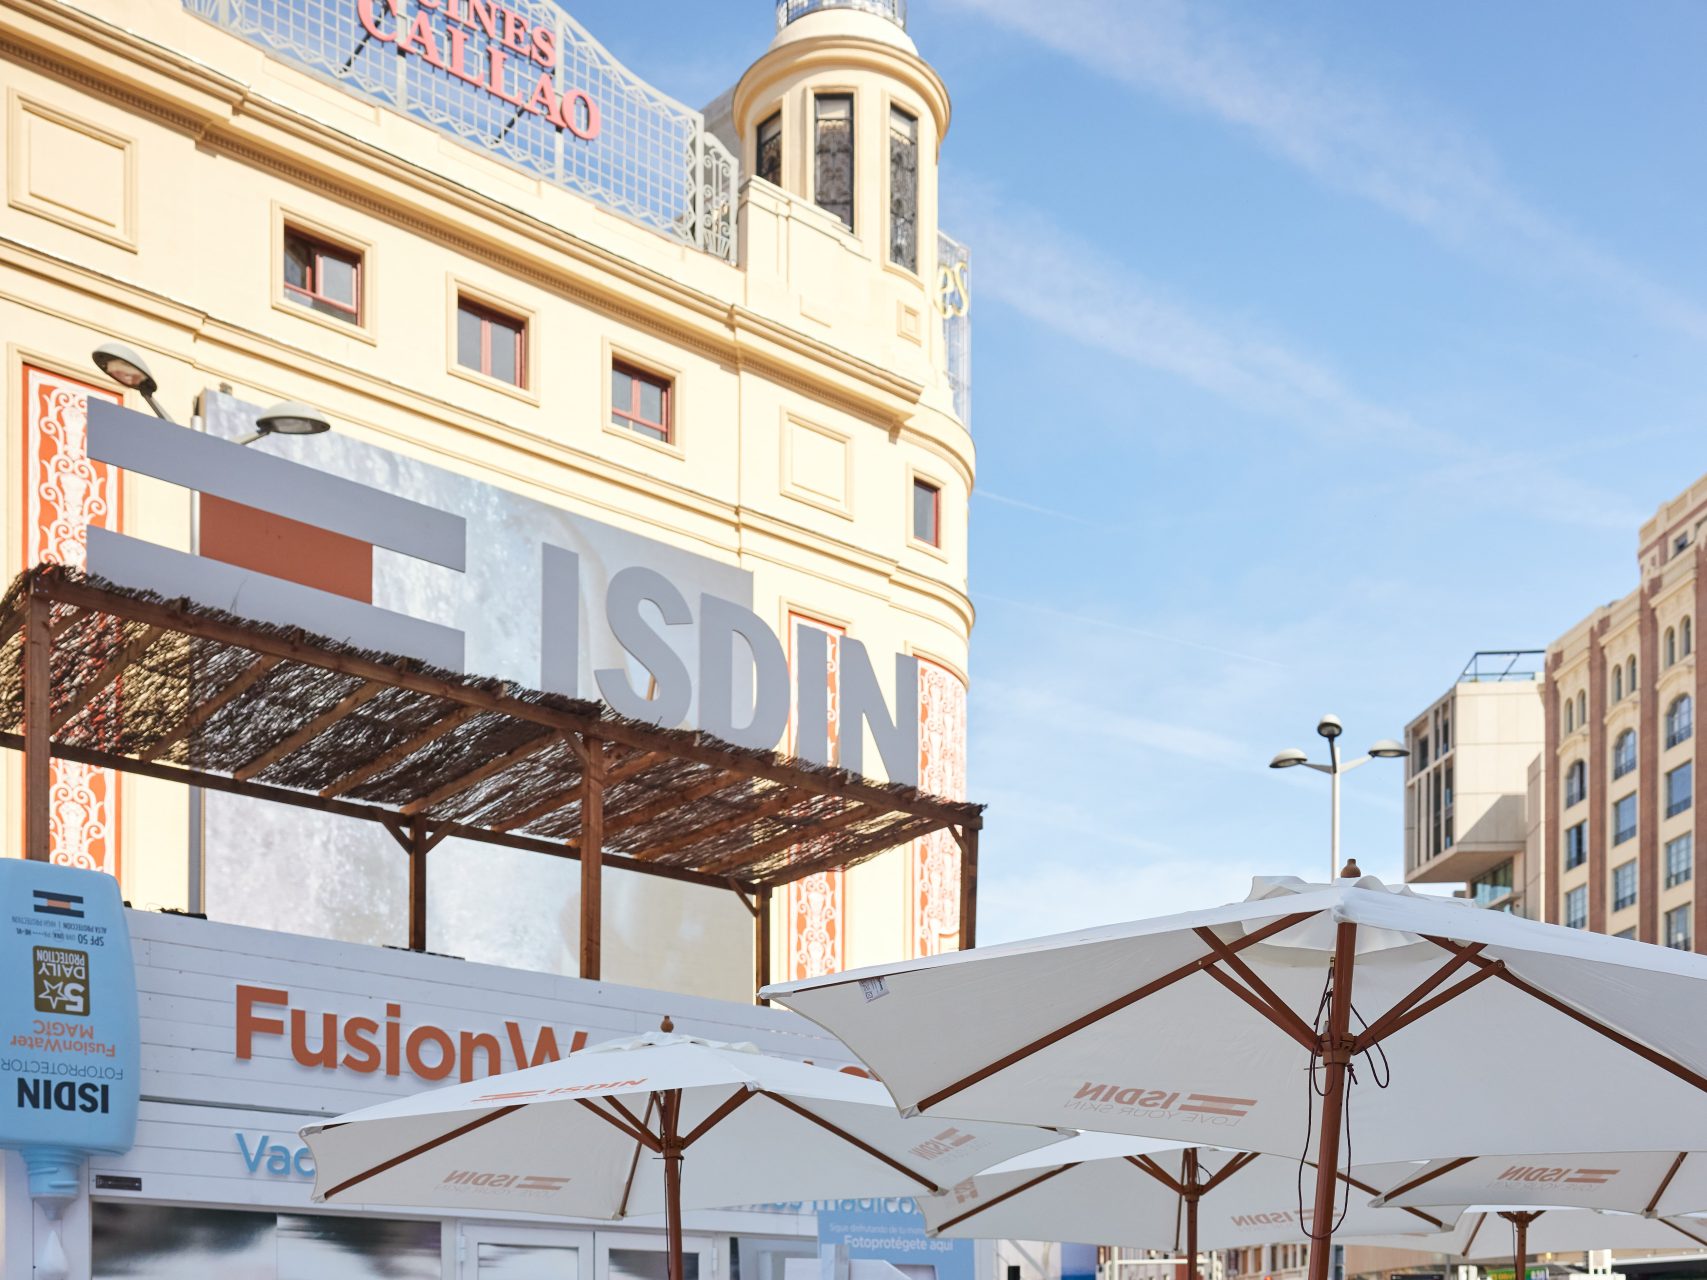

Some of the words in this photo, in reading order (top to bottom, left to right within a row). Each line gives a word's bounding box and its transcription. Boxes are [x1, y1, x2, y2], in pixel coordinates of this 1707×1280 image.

[417, 0, 556, 67] INES
[357, 0, 600, 141] CALLAO
[540, 542, 918, 790] ISDIN
[77, 933, 88, 945] 50
[90, 936, 105, 947] SPF
[36, 949, 85, 966] PROTECTION
[38, 962, 86, 980] DAILY
[64, 982, 85, 1012] 5
[10, 1034, 116, 1057] FusionWater
[0, 1058, 124, 1080] FOTOPROTECTOR
[17, 1077, 109, 1114] ISDIN
[844, 1234, 927, 1251] Fotoprotégete
